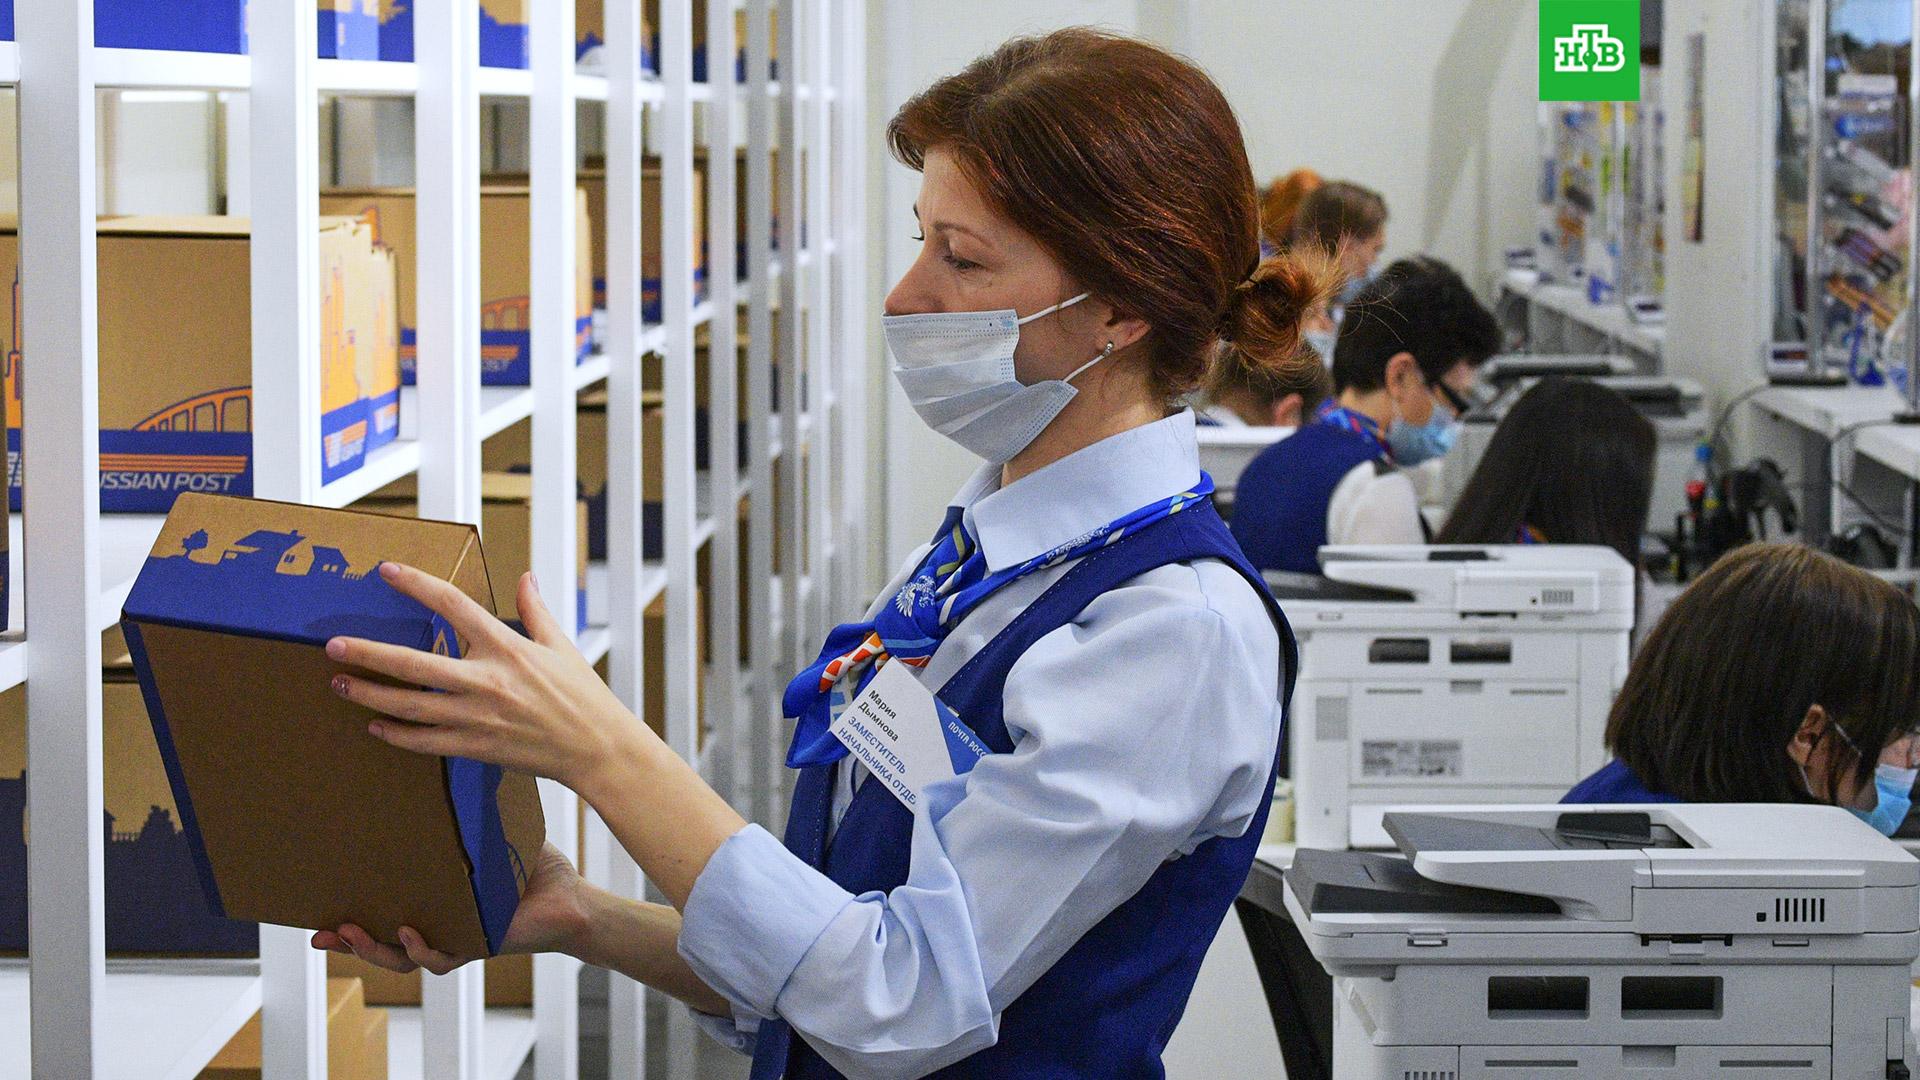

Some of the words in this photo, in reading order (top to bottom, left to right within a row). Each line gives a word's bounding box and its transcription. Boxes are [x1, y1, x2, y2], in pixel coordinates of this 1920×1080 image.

[173, 473, 236, 491] POST
[858, 701, 899, 742] Дымнова
[868, 690, 896, 719] Мария
[848, 716, 906, 774] ЗАМЕСТИТЕЛЬ
[948, 721, 970, 744] ПОЧТА
[838, 727, 892, 782] НАЧАЛЬНИКА
[892, 780, 917, 805] ОТДЕ
